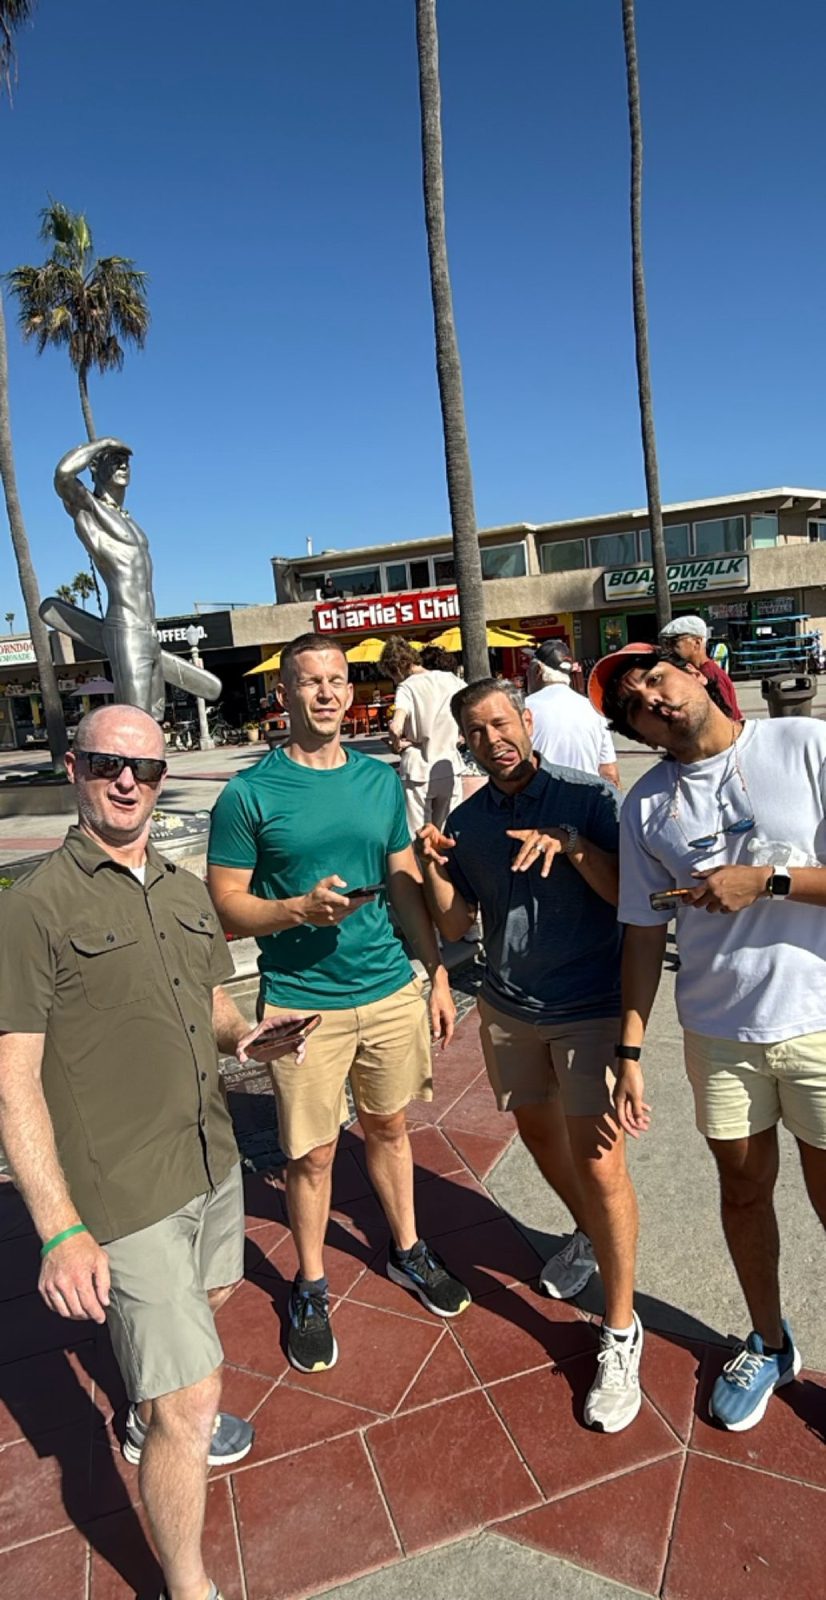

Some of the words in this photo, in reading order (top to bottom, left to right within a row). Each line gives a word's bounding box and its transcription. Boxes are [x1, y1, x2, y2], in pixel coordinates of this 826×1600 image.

[608, 559, 744, 586] BOADWALK
[646, 578, 708, 597] SORTS
[318, 602, 413, 629] Charlie's
[418, 594, 460, 619] Chil
[157, 628, 188, 642] OFFEE
